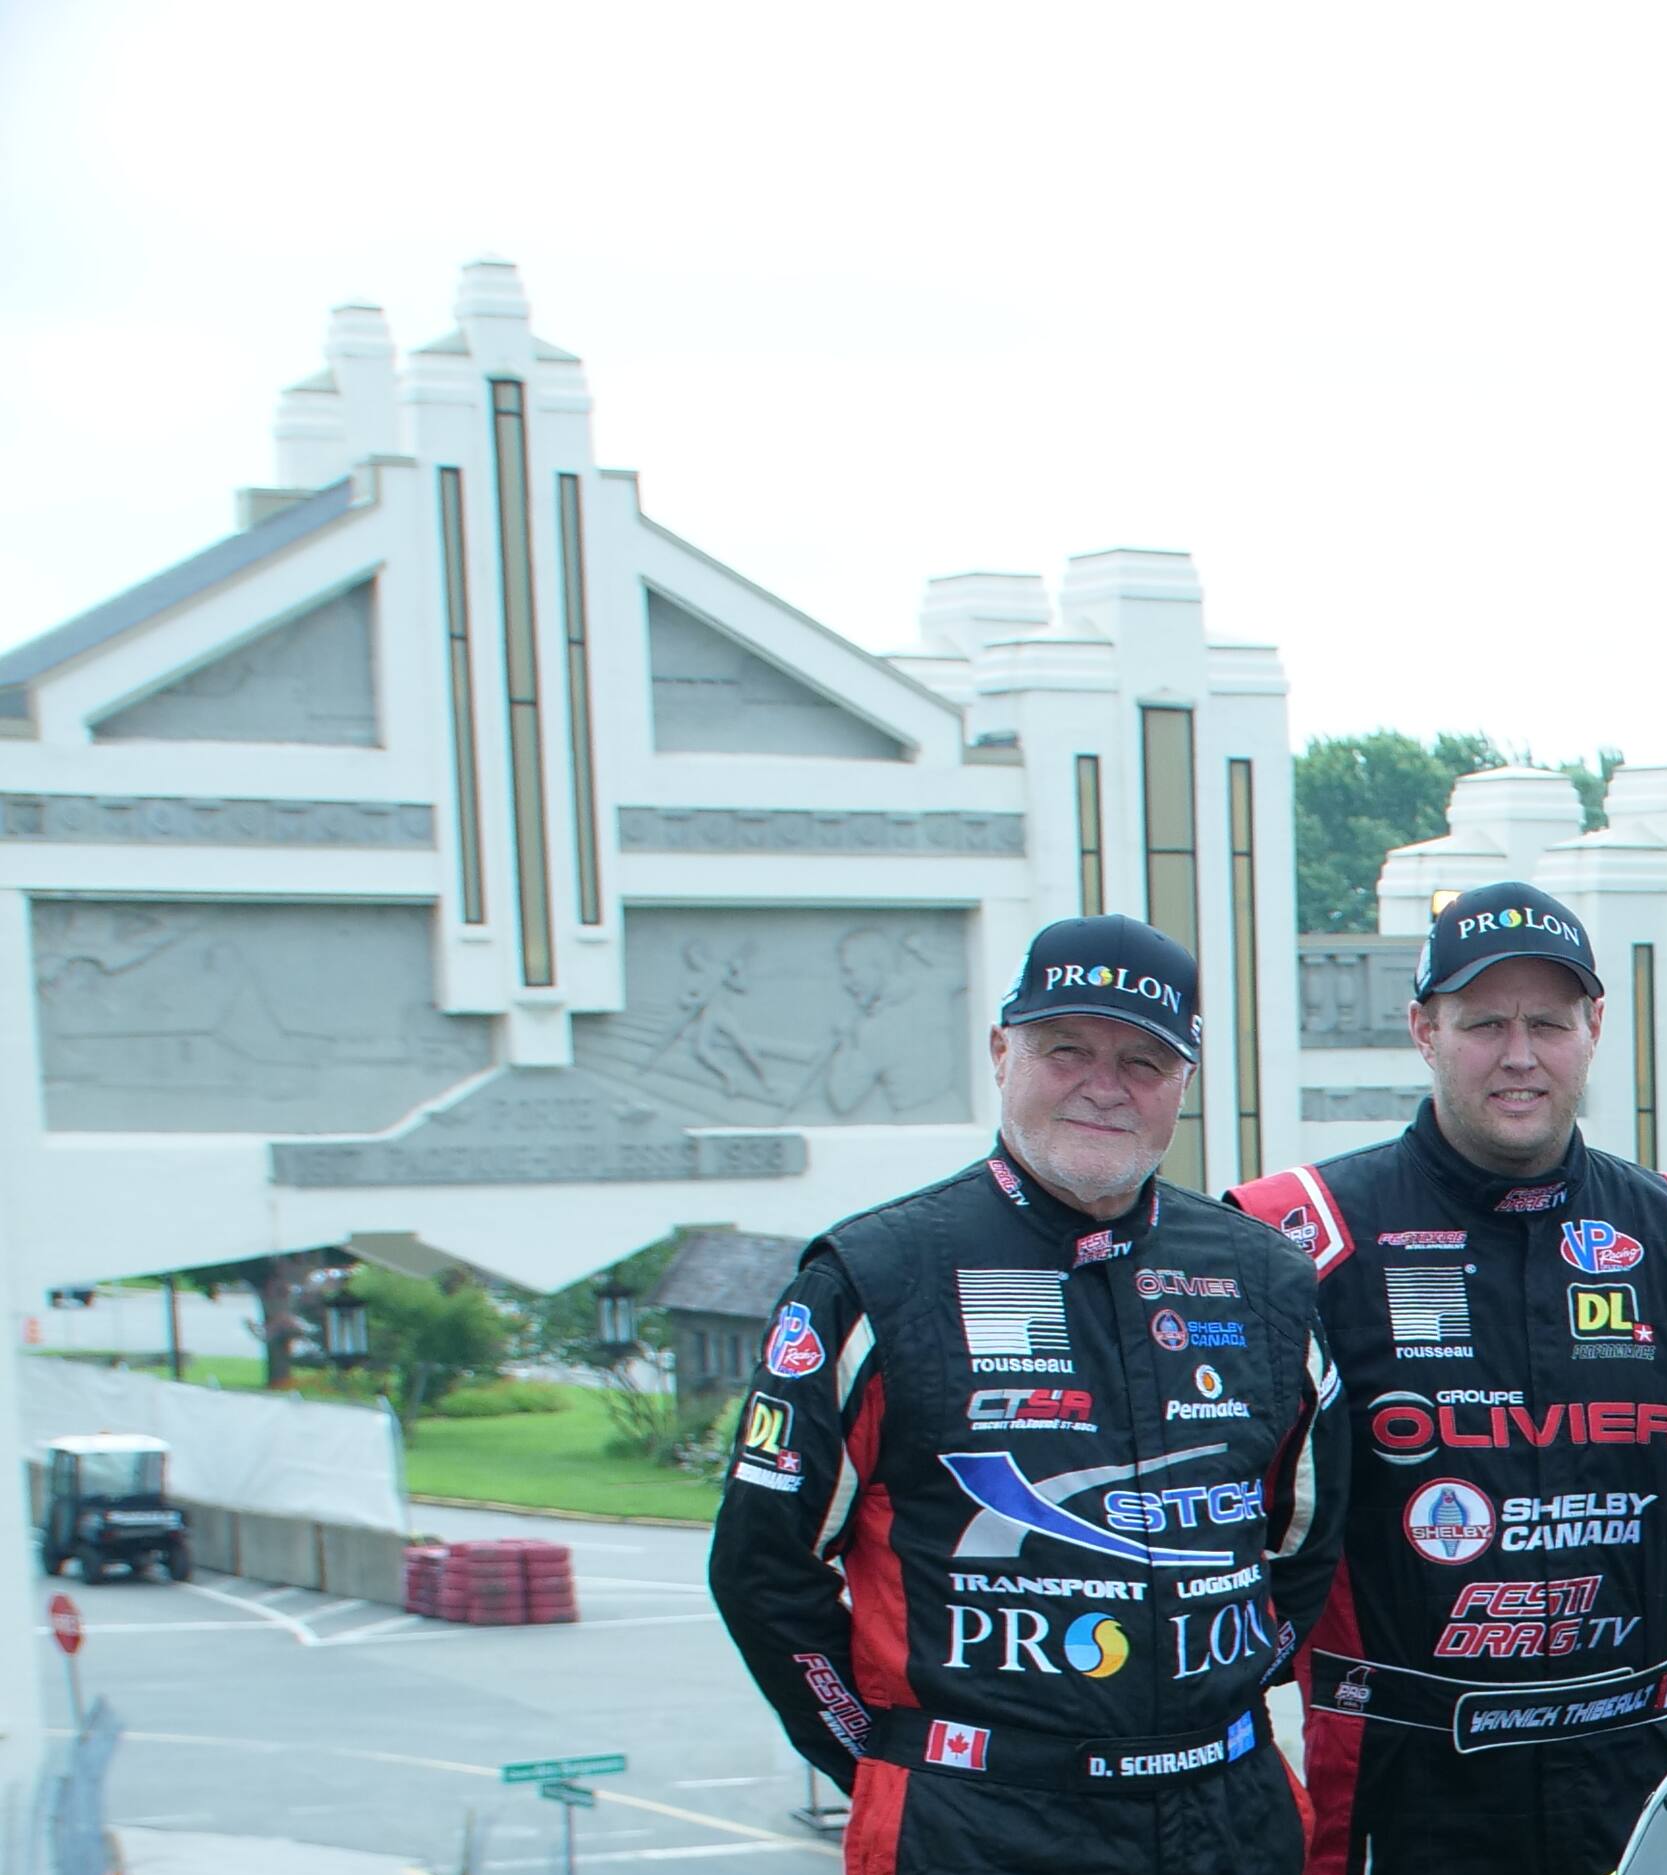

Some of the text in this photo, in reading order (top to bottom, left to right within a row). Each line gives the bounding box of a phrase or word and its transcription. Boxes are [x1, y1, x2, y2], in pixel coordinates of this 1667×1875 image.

[1458, 907, 1580, 947] PROLON
[1045, 964, 1182, 1015] PROLON
[1561, 1219, 1616, 1273] VP
[1599, 1246, 1640, 1264] Racing
[1136, 1272, 1240, 1298] OLIVIER
[1577, 1292, 1632, 1330] DL
[1187, 1321, 1244, 1335] SHELBY
[1190, 1333, 1247, 1349] CANADA
[971, 1356, 1074, 1375] rousseau
[1396, 1345, 1474, 1359] rousseau
[1166, 1400, 1251, 1422] Permatex
[1436, 1390, 1524, 1405] GROUPE
[745, 1402, 785, 1454] DL
[1501, 1493, 1659, 1524] SHELBY
[1412, 1525, 1490, 1539] SHELBY
[1501, 1520, 1641, 1552] CANADA
[948, 1573, 1148, 1600] TRANSPORT
[1176, 1565, 1262, 1599] LOGISTIQUE
[1450, 1575, 1603, 1619] FESTI
[1433, 1616, 1643, 1658] DRAG.TV
[1334, 1681, 1373, 1702] PRO
[1469, 1703, 1560, 1733] YANNICK
[1088, 1740, 1225, 1777] D. SCHRAENEN
